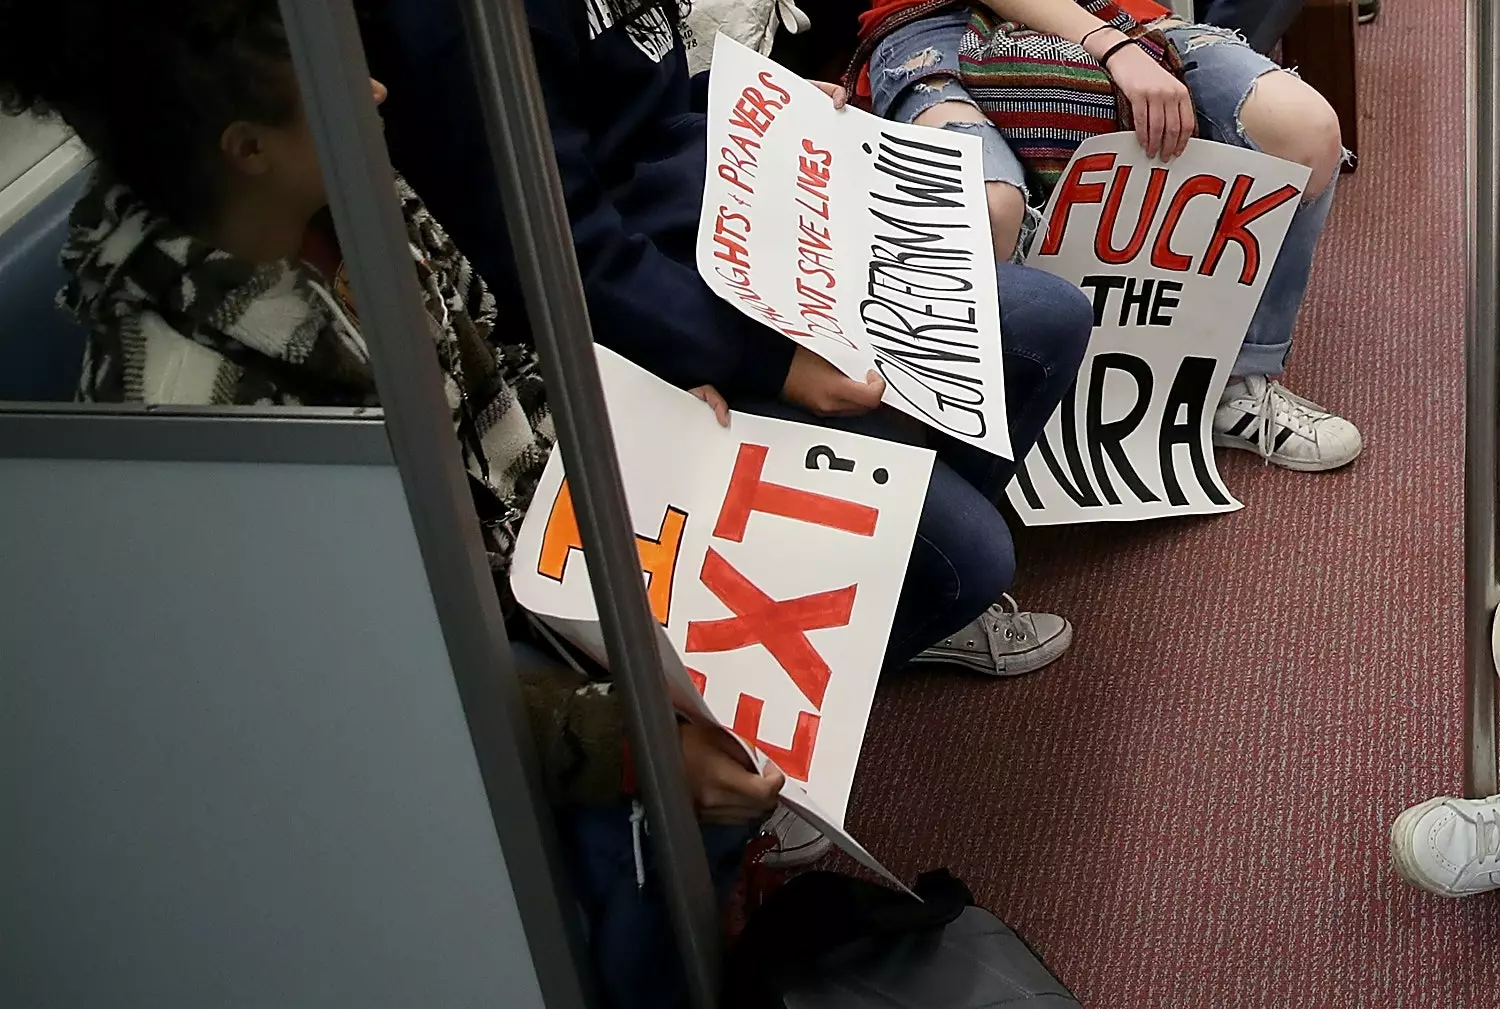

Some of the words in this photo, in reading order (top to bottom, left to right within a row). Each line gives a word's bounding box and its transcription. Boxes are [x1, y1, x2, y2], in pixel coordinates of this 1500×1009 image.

[718, 71, 792, 196] PRAYERS
[795, 137, 833, 222] LIVES
[713, 203, 814, 341] THOUGHTS
[796, 213, 836, 289] SAVE
[859, 207, 979, 339] REFORM
[1037, 151, 1301, 286] FUCK
[795, 279, 859, 351] DONT
[1079, 275, 1184, 327] THE
[1015, 352, 1232, 511] NRA
[684, 442, 890, 784] EXT?
